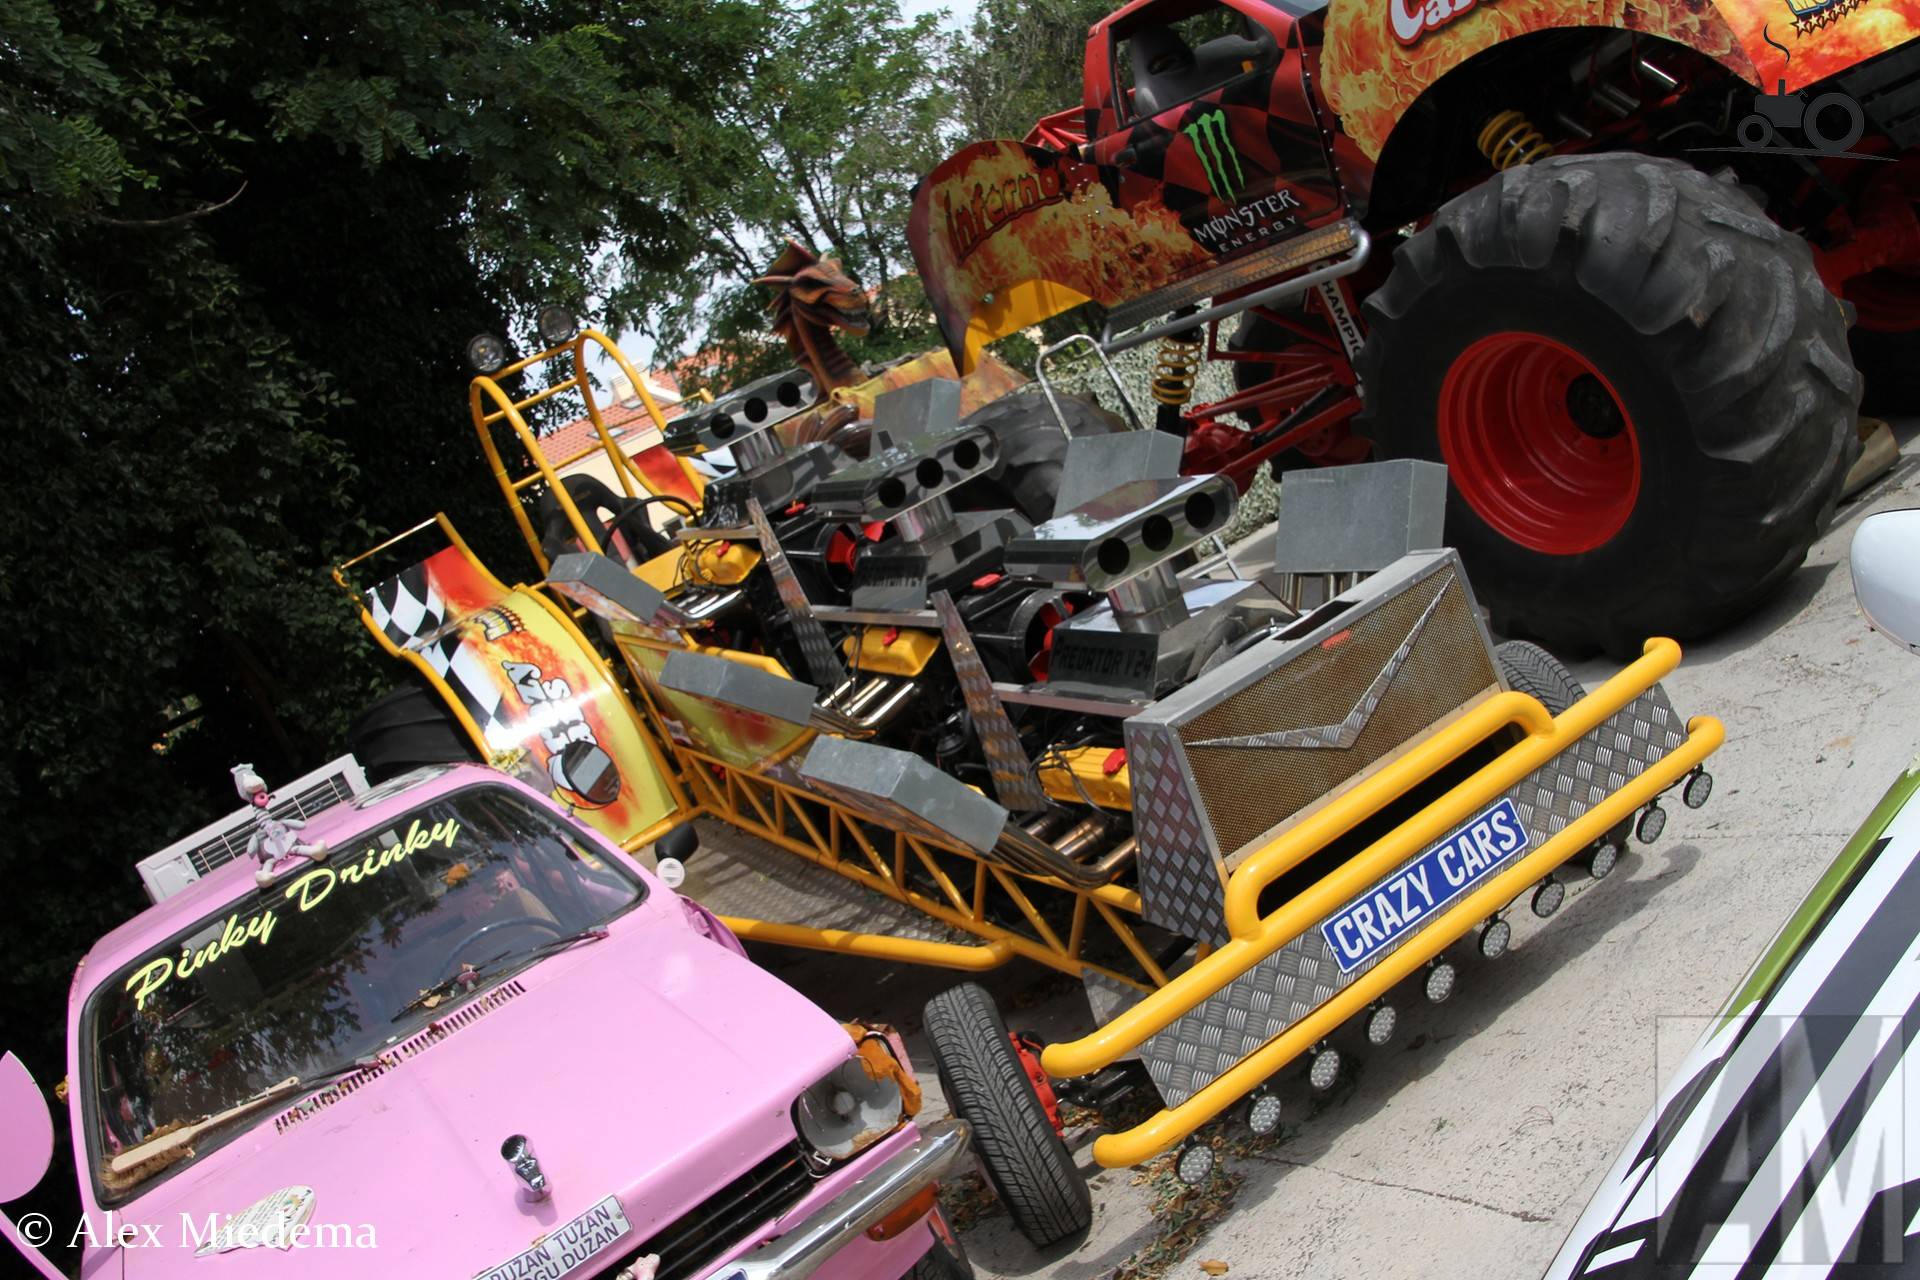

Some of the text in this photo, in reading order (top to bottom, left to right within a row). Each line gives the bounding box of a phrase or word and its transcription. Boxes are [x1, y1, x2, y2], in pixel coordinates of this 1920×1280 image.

[1193, 189, 1300, 242] MONSTER
[1219, 215, 1297, 253] ENERGY
[126, 818, 460, 1011] Pinky Drinky
[1333, 810, 1517, 959] CRAZY CARS
